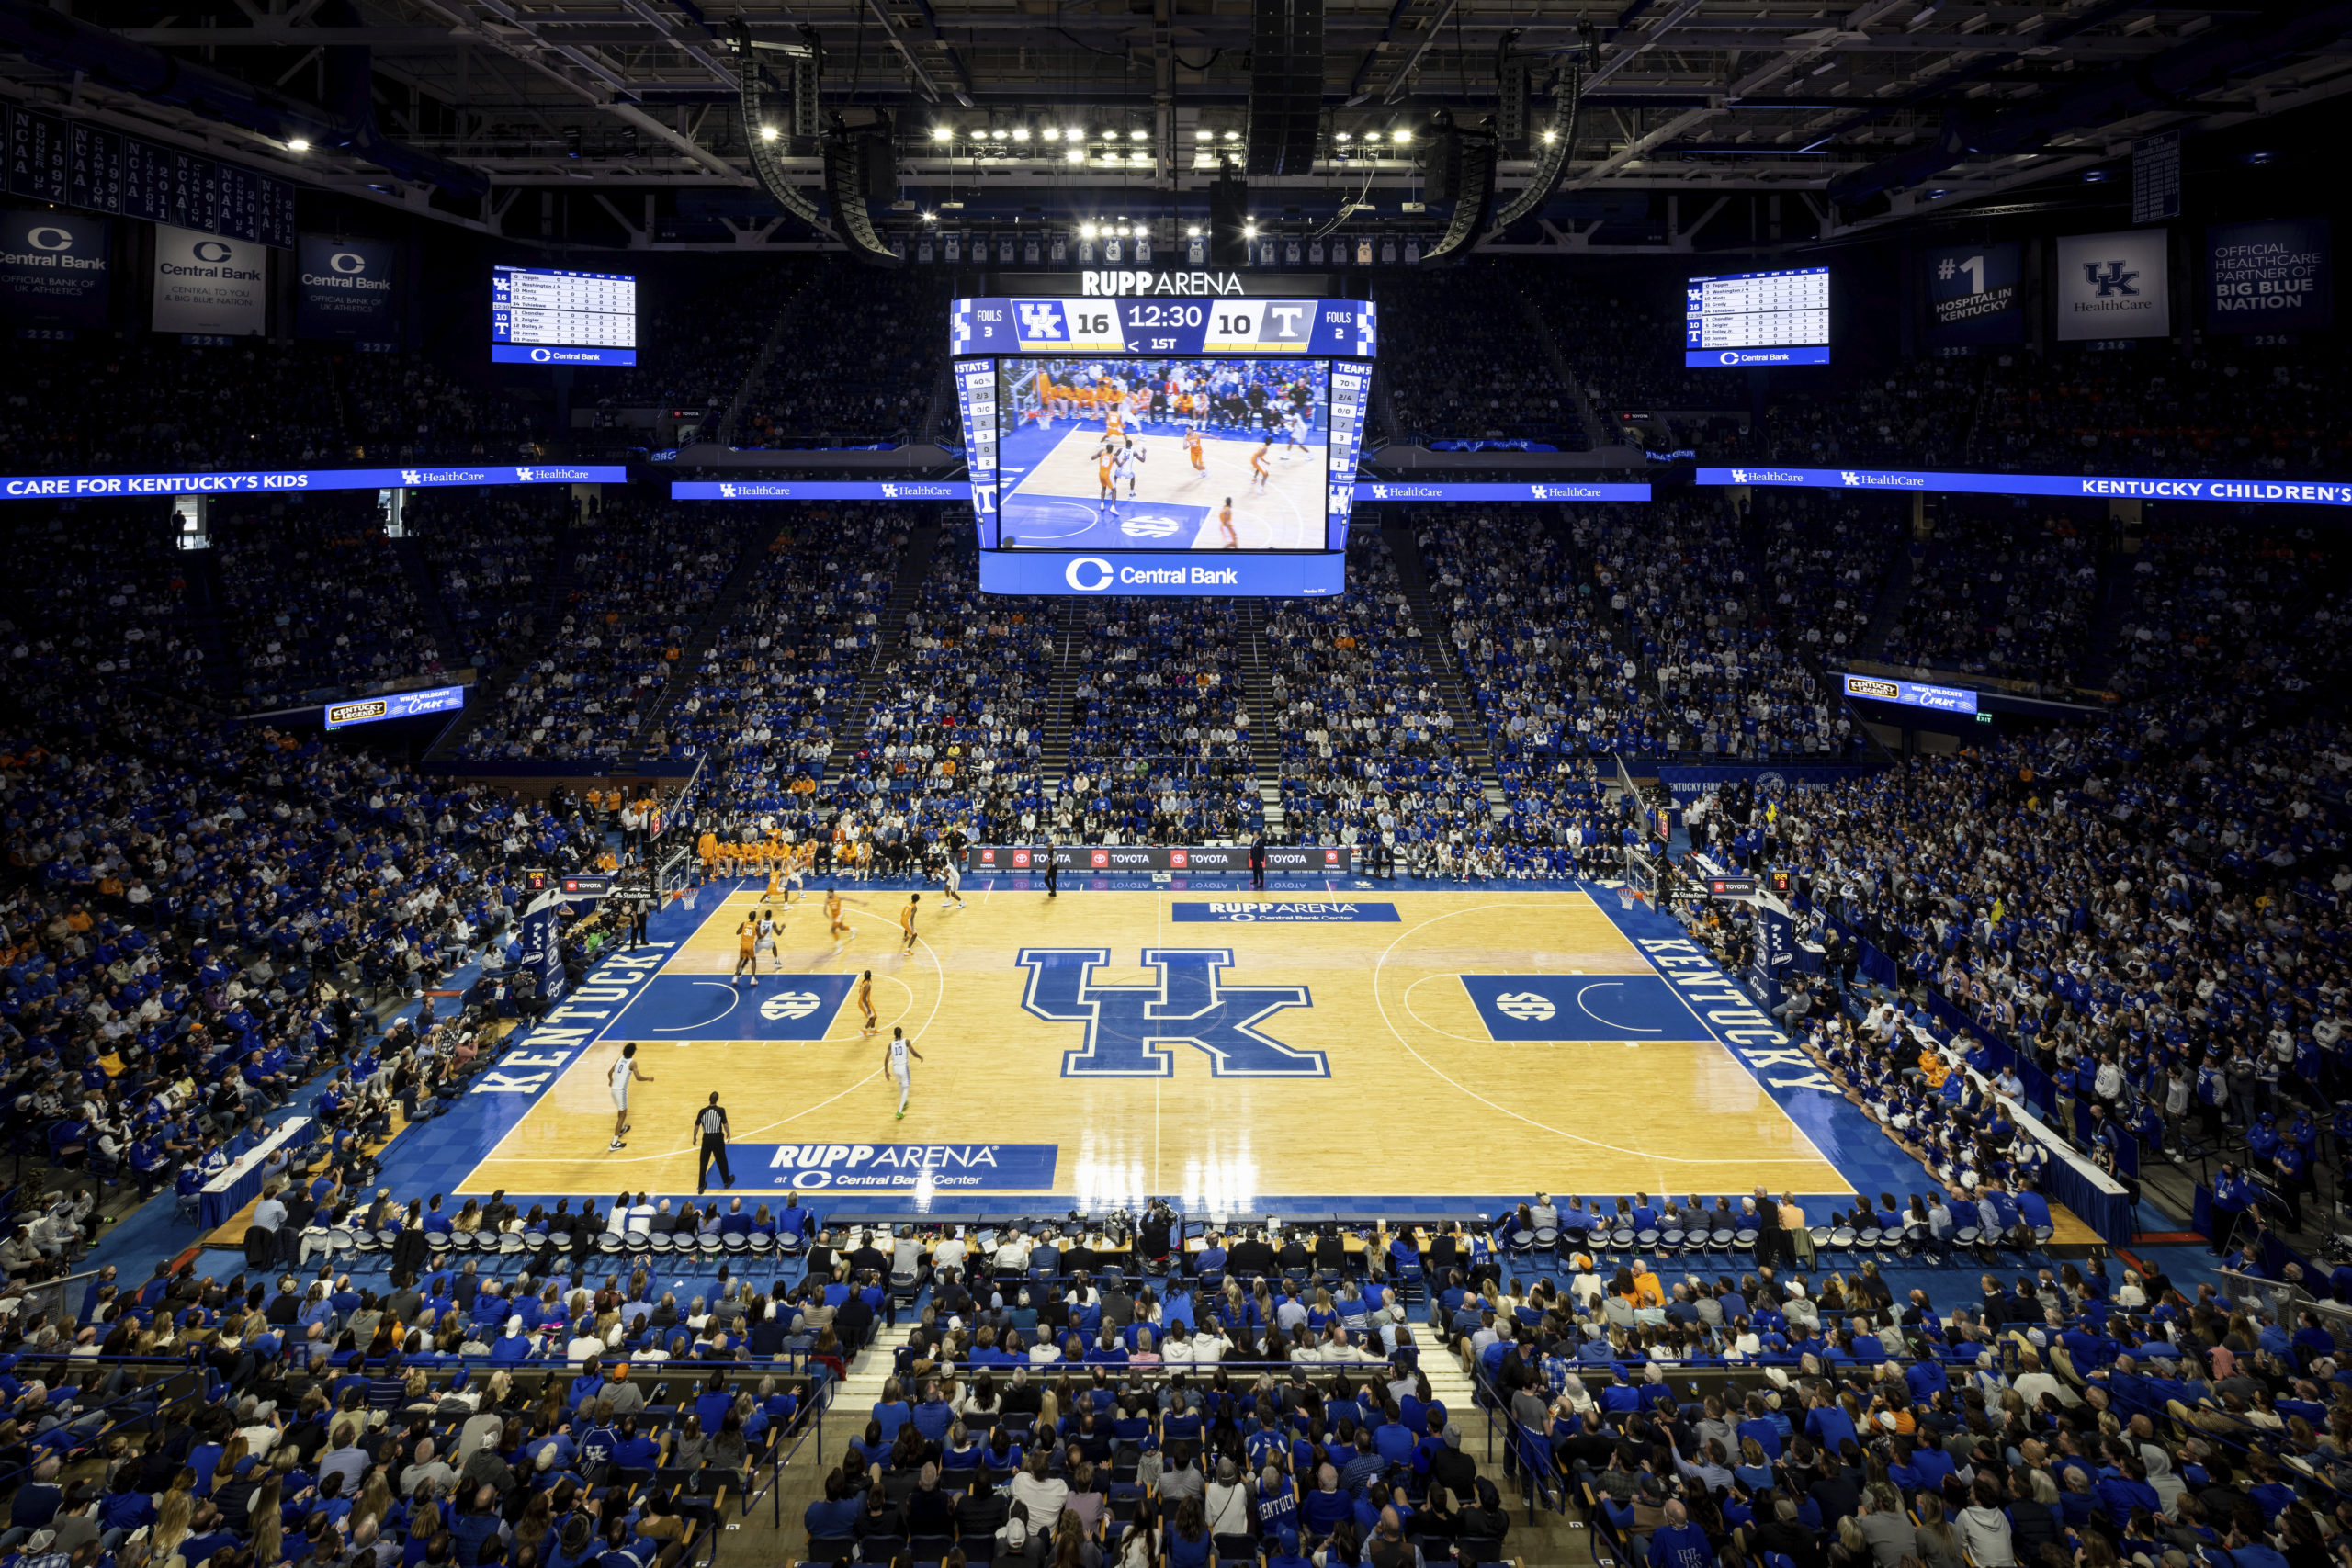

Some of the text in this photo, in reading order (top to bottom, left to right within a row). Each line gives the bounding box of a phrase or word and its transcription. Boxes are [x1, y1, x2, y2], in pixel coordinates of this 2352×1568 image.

[15, 112, 29, 174] NCAA
[74, 128, 88, 186] NCAA
[51, 140, 63, 196] 1997
[127, 141, 140, 197] NCAA
[107, 154, 119, 208] 1998
[176, 156, 188, 209] NCAA
[158, 166, 169, 219] 2011
[221, 168, 232, 219] NCAA
[205, 179, 214, 229] 2012
[246, 191, 255, 238] 2014
[285, 200, 293, 245] 2015
[2215, 243, 2289, 258] OFFICIAL
[62, 255, 106, 271] Bank
[2215, 253, 2323, 270] HEALTHCARE
[160, 263, 261, 282] Central Bank
[1938, 256, 1984, 294] #1
[2084, 260, 2139, 298] UK
[2216, 265, 2316, 282] PARTNER OF
[1, 275, 96, 288] OFFICIAL BANK OF
[301, 273, 390, 291] Central Bank
[1082, 271, 1245, 296] RUPP ARENA
[2216, 278, 2314, 297] BIG BLUE
[15, 285, 83, 296] UK ATHLETICS
[171, 286, 250, 298] CENTRAL TO YOU
[175, 295, 213, 304] BIG BLUE
[310, 294, 344, 304] OFFICIAL
[347, 297, 368, 306] BANK
[1936, 288, 2012, 313] HOSPITAL IN
[2075, 300, 2152, 312] HealthCare
[2217, 294, 2302, 311] NATION
[321, 303, 373, 313] UK ATHLETICS
[1940, 299, 2008, 323] KENTUCKY
[977, 310, 1002, 322] FOULS
[1020, 304, 1062, 338] UK
[1128, 306, 1203, 327] 12:30
[1272, 307, 1303, 337] T
[1326, 311, 1351, 323] FOULS
[495, 322, 509, 334] T
[1078, 314, 1110, 334] 16
[1219, 315, 1251, 335] 10
[984, 326, 993, 338] 3
[1335, 328, 1344, 340] 2
[1689, 331, 1702, 342] T
[2255, 334, 2287, 345] 236
[1151, 338, 1177, 349] 1ST
[582, 353, 600, 361] Bank
[1742, 353, 1789, 362] Central Bank
[958, 361, 989, 373] STATS
[1338, 363, 1365, 375] TEAM
[401, 469, 484, 484] UK HealthCare
[516, 468, 589, 481] UK HealthCare
[1732, 469, 1804, 482] UK HealthCare
[1841, 471, 1925, 486] UK HealthCare
[6, 474, 309, 495] CARE FOR KENTUCKY'S KIDS
[720, 483, 790, 497] UK HealthCare
[882, 483, 952, 497] UK HealthCare
[1372, 485, 1442, 499] UK HealthCare
[1532, 485, 1601, 499] UK HealthCare
[2082, 479, 2352, 502] KENTUCKY CHILDREN'S
[1120, 567, 1238, 584] Central Bank
[1850, 680, 1896, 693] KENTUCKY
[1858, 686, 1888, 695] LEGEND
[1930, 688, 1962, 697] WILDCATS
[400, 691, 450, 703] WHAT WILDCATS
[1920, 692, 1956, 707] Crave
[333, 702, 383, 717] KENTUCKY
[408, 699, 444, 714] Crave
[341, 709, 375, 720] LEGEND
[1668, 783, 1702, 792] ENTUCKY
[1112, 854, 1149, 863] TOYOTA
[1191, 855, 1228, 863] TOYOTA
[1269, 855, 1306, 863] TOYOTA
[1210, 903, 1359, 913] RUPP ARENA
[744, 928, 752, 936] 30
[547, 977, 565, 998] Kroger
[760, 991, 820, 1021] SEC
[1017, 947, 1331, 1078] UK
[1496, 991, 1556, 1021] SEC
[470, 939, 676, 1095] KENTUCKY
[1638, 937, 1842, 1094] KENTUCKY
[894, 1046, 903, 1056] 10
[617, 1064, 624, 1073] 0
[769, 1145, 998, 1168] RUPP ARENA
[774, 1175, 982, 1185] at Central Center
